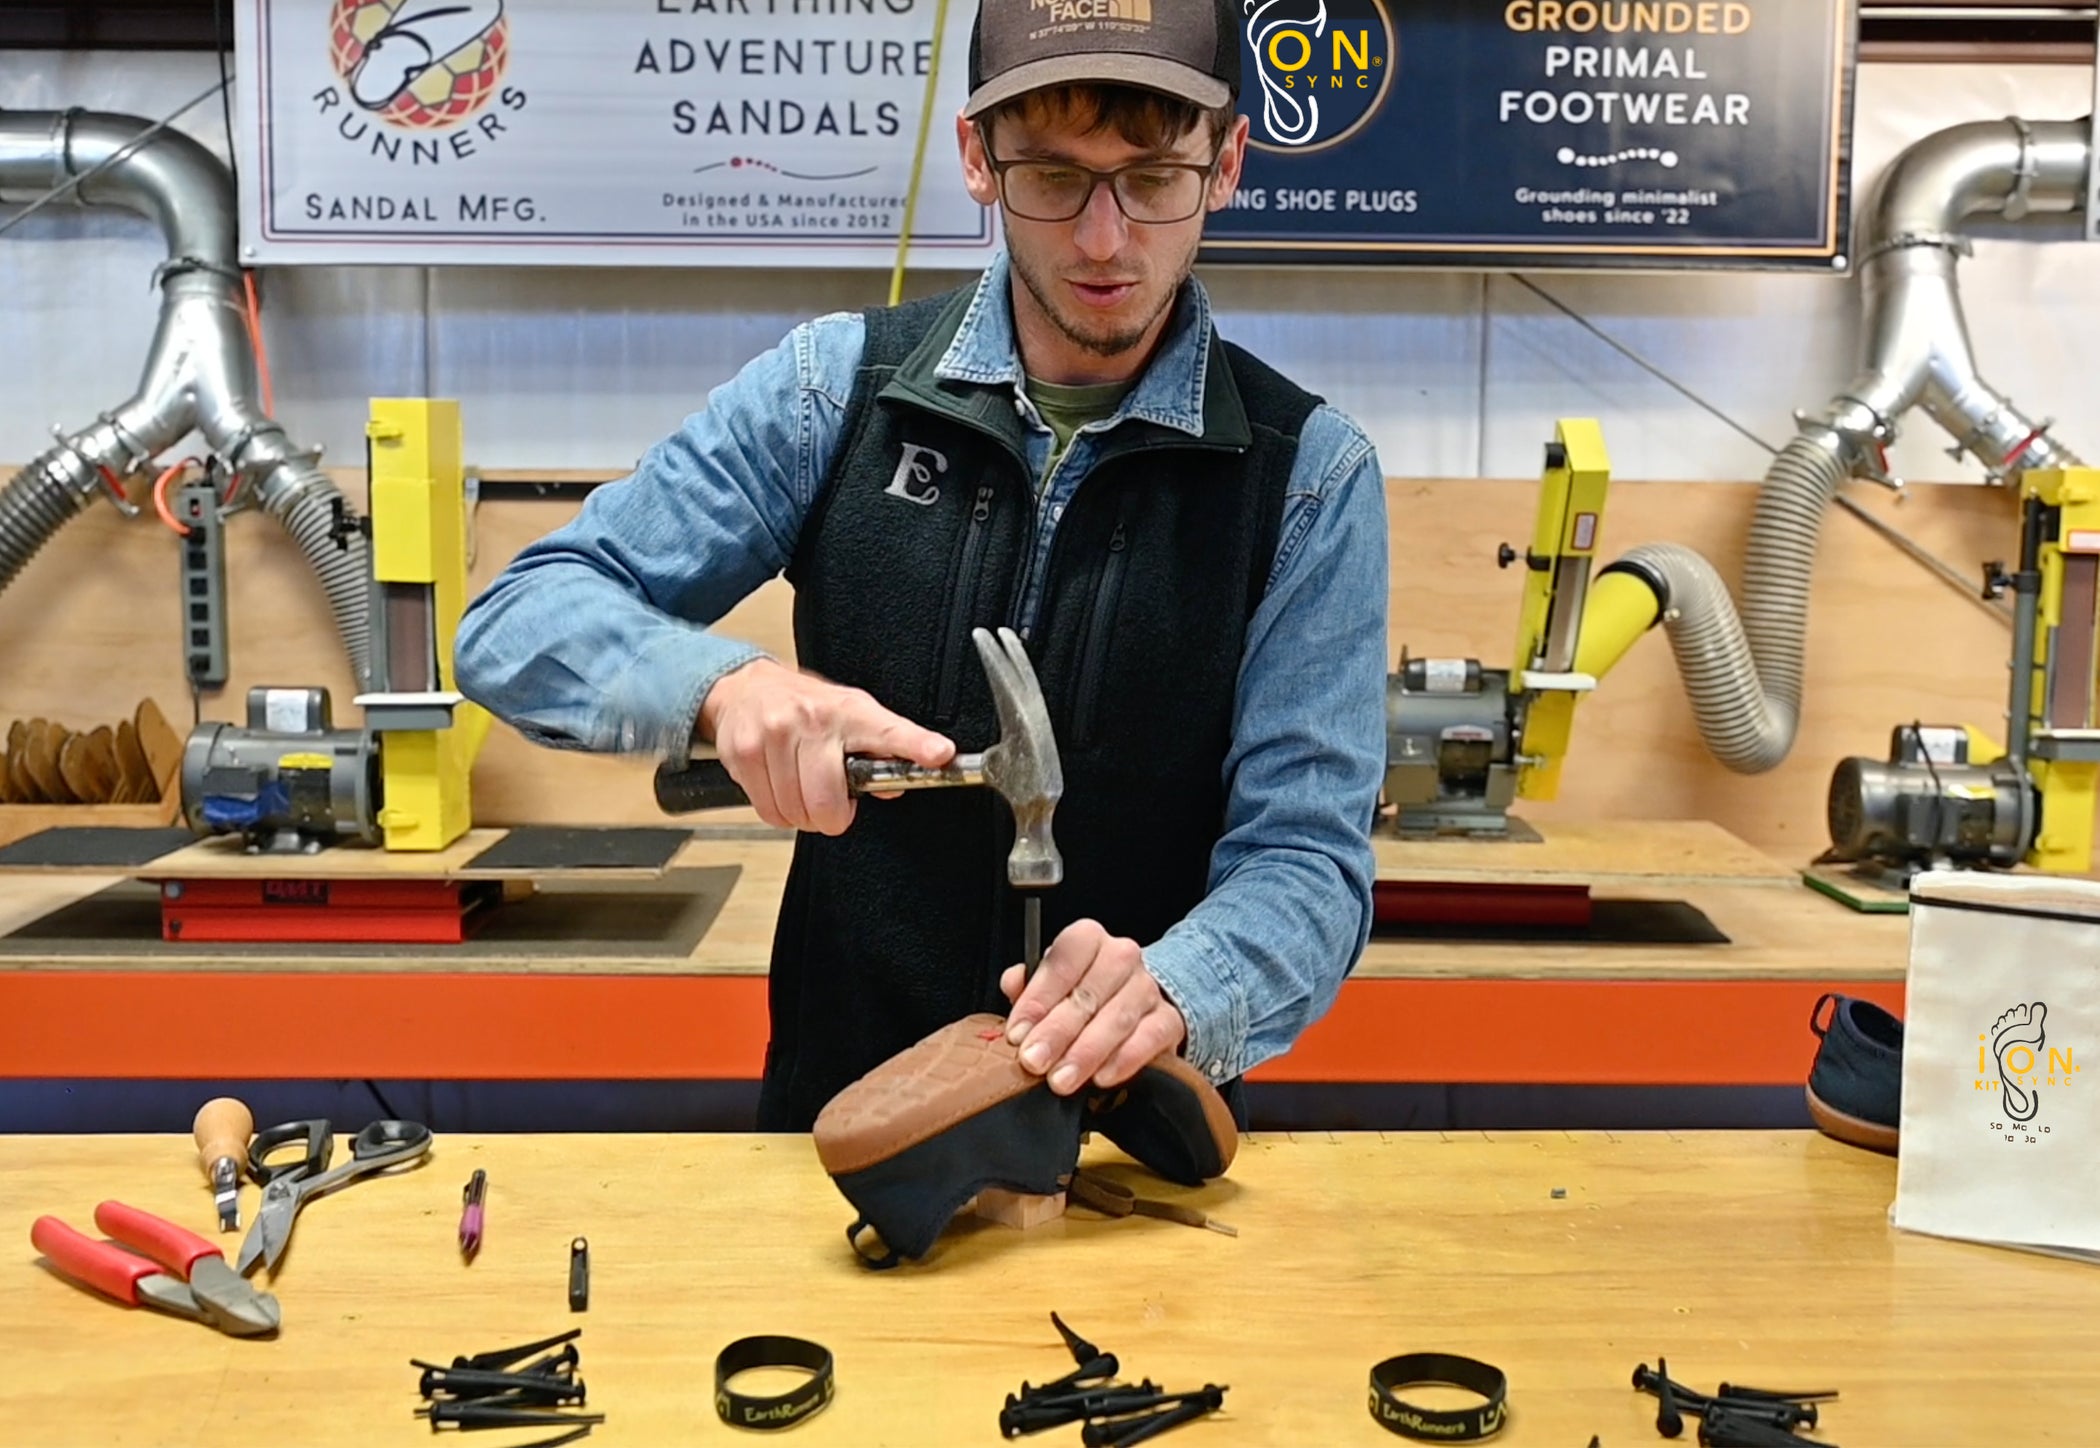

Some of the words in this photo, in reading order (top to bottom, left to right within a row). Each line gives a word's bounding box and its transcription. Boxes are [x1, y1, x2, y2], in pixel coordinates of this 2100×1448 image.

[1049, 0, 1108, 22] FACE
[1504, 0, 1751, 34] GROUNDED
[634, 38, 933, 76] ADVENTURE
[1545, 46, 1707, 79] PRIMAL
[1284, 75, 1369, 89] SYNC
[672, 100, 900, 136] SANDALS
[1499, 90, 1750, 125] FOOTWEAR
[312, 86, 528, 165] RUNNERS
[306, 193, 438, 221] SANDAL
[458, 195, 547, 222] MFG.
[662, 193, 751, 209] Designed
[757, 194, 770, 207] &
[1275, 188, 1336, 211] SHOE
[1345, 190, 1418, 212] PLUGS
[1514, 187, 1616, 208] Grounding
[1621, 189, 1718, 206] minimalist
[683, 213, 700, 227] in
[707, 213, 739, 228] the
[746, 214, 783, 228] USA
[791, 214, 840, 228] since
[846, 214, 891, 228] 2012
[1541, 208, 1597, 223] shoes
[1604, 208, 1655, 224] since
[1974, 1080, 2001, 1091] KIT
[2016, 1076, 2073, 1087] SYNC
